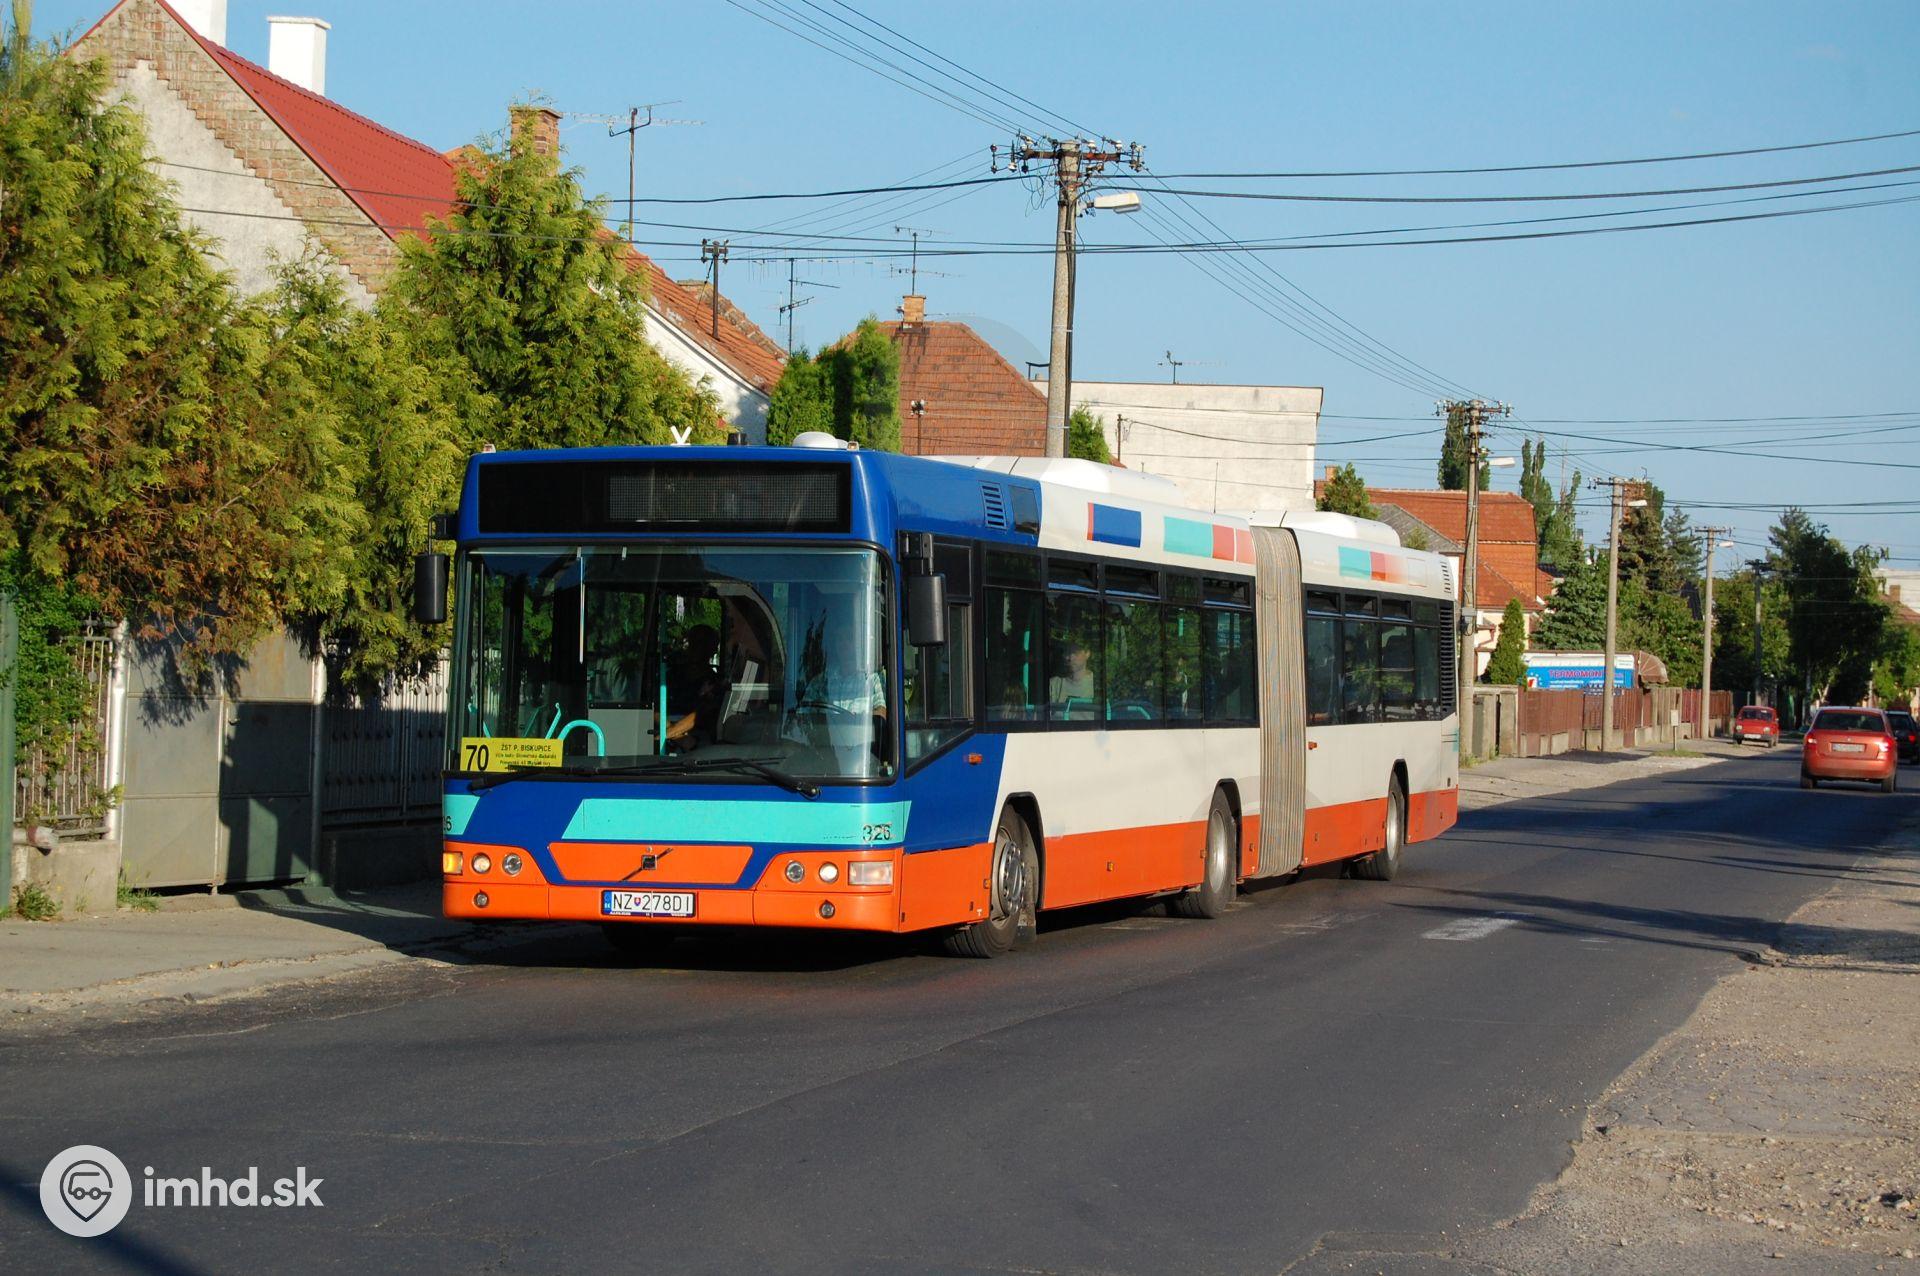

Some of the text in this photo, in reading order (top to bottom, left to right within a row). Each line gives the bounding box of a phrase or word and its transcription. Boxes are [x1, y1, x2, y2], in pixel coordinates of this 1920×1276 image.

[1549, 670, 1604, 678] TERMOMON
[521, 744, 552, 752] BISKUPICE
[466, 744, 489, 771] 70
[863, 824, 890, 841] 326
